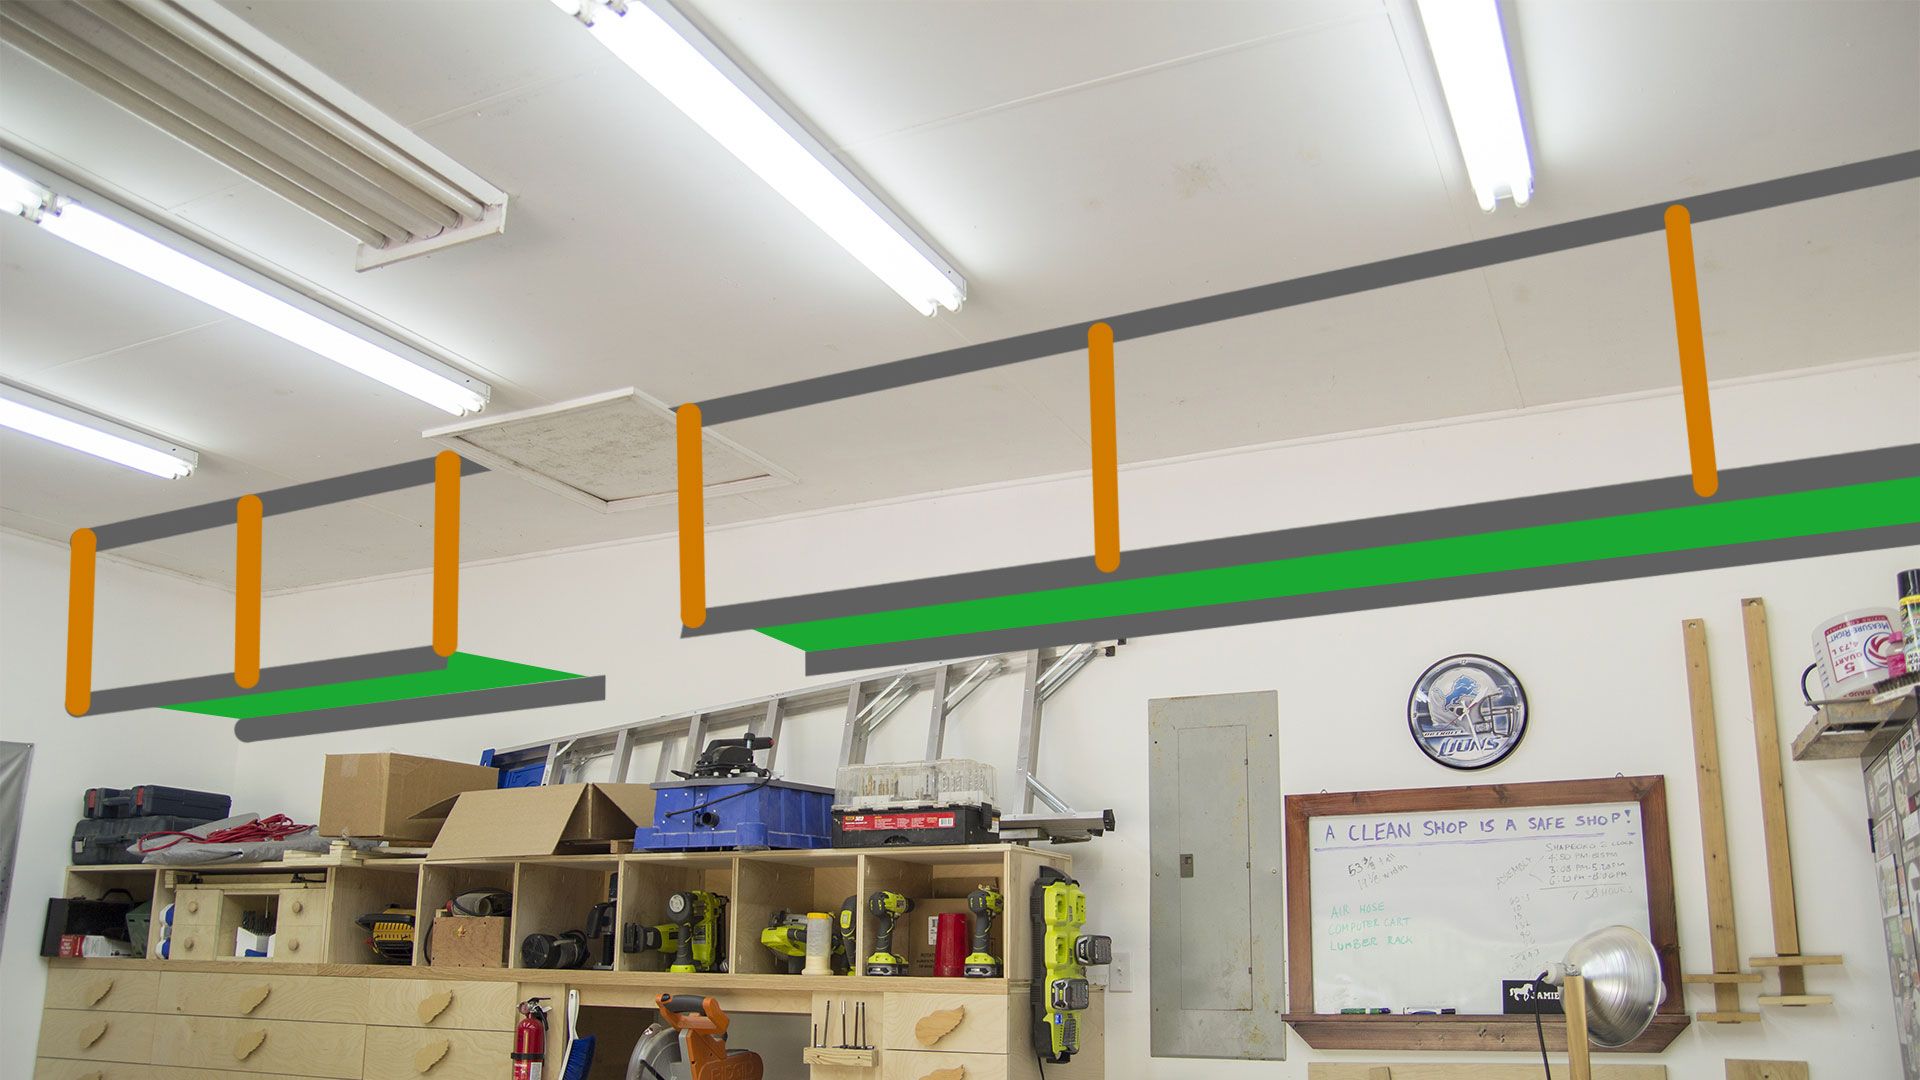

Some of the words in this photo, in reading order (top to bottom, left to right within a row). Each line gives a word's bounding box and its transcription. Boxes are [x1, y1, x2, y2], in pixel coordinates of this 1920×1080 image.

[1853, 622, 1889, 634] MEASURE
[1829, 630, 1852, 642] RIGHT
[1835, 652, 1862, 667] QUART
[1844, 662, 1855, 674] 5
[1437, 736, 1502, 757] LIONS
[1325, 824, 1335, 842] A
[1348, 822, 1411, 841] CLEAN
[1423, 820, 1468, 836] SHOP
[1480, 819, 1495, 832] IS
[1505, 818, 1517, 831] A
[1528, 816, 1565, 831] SAFE
[1575, 809, 1632, 827] SHOP!
[1331, 904, 1350, 918] AIR
[1360, 901, 1385, 913] HOSE
[1328, 918, 1379, 935] COMPUTER
[1384, 917, 1412, 927] CART
[1329, 937, 1378, 951] LUMBER
[1387, 936, 1413, 945] RACK
